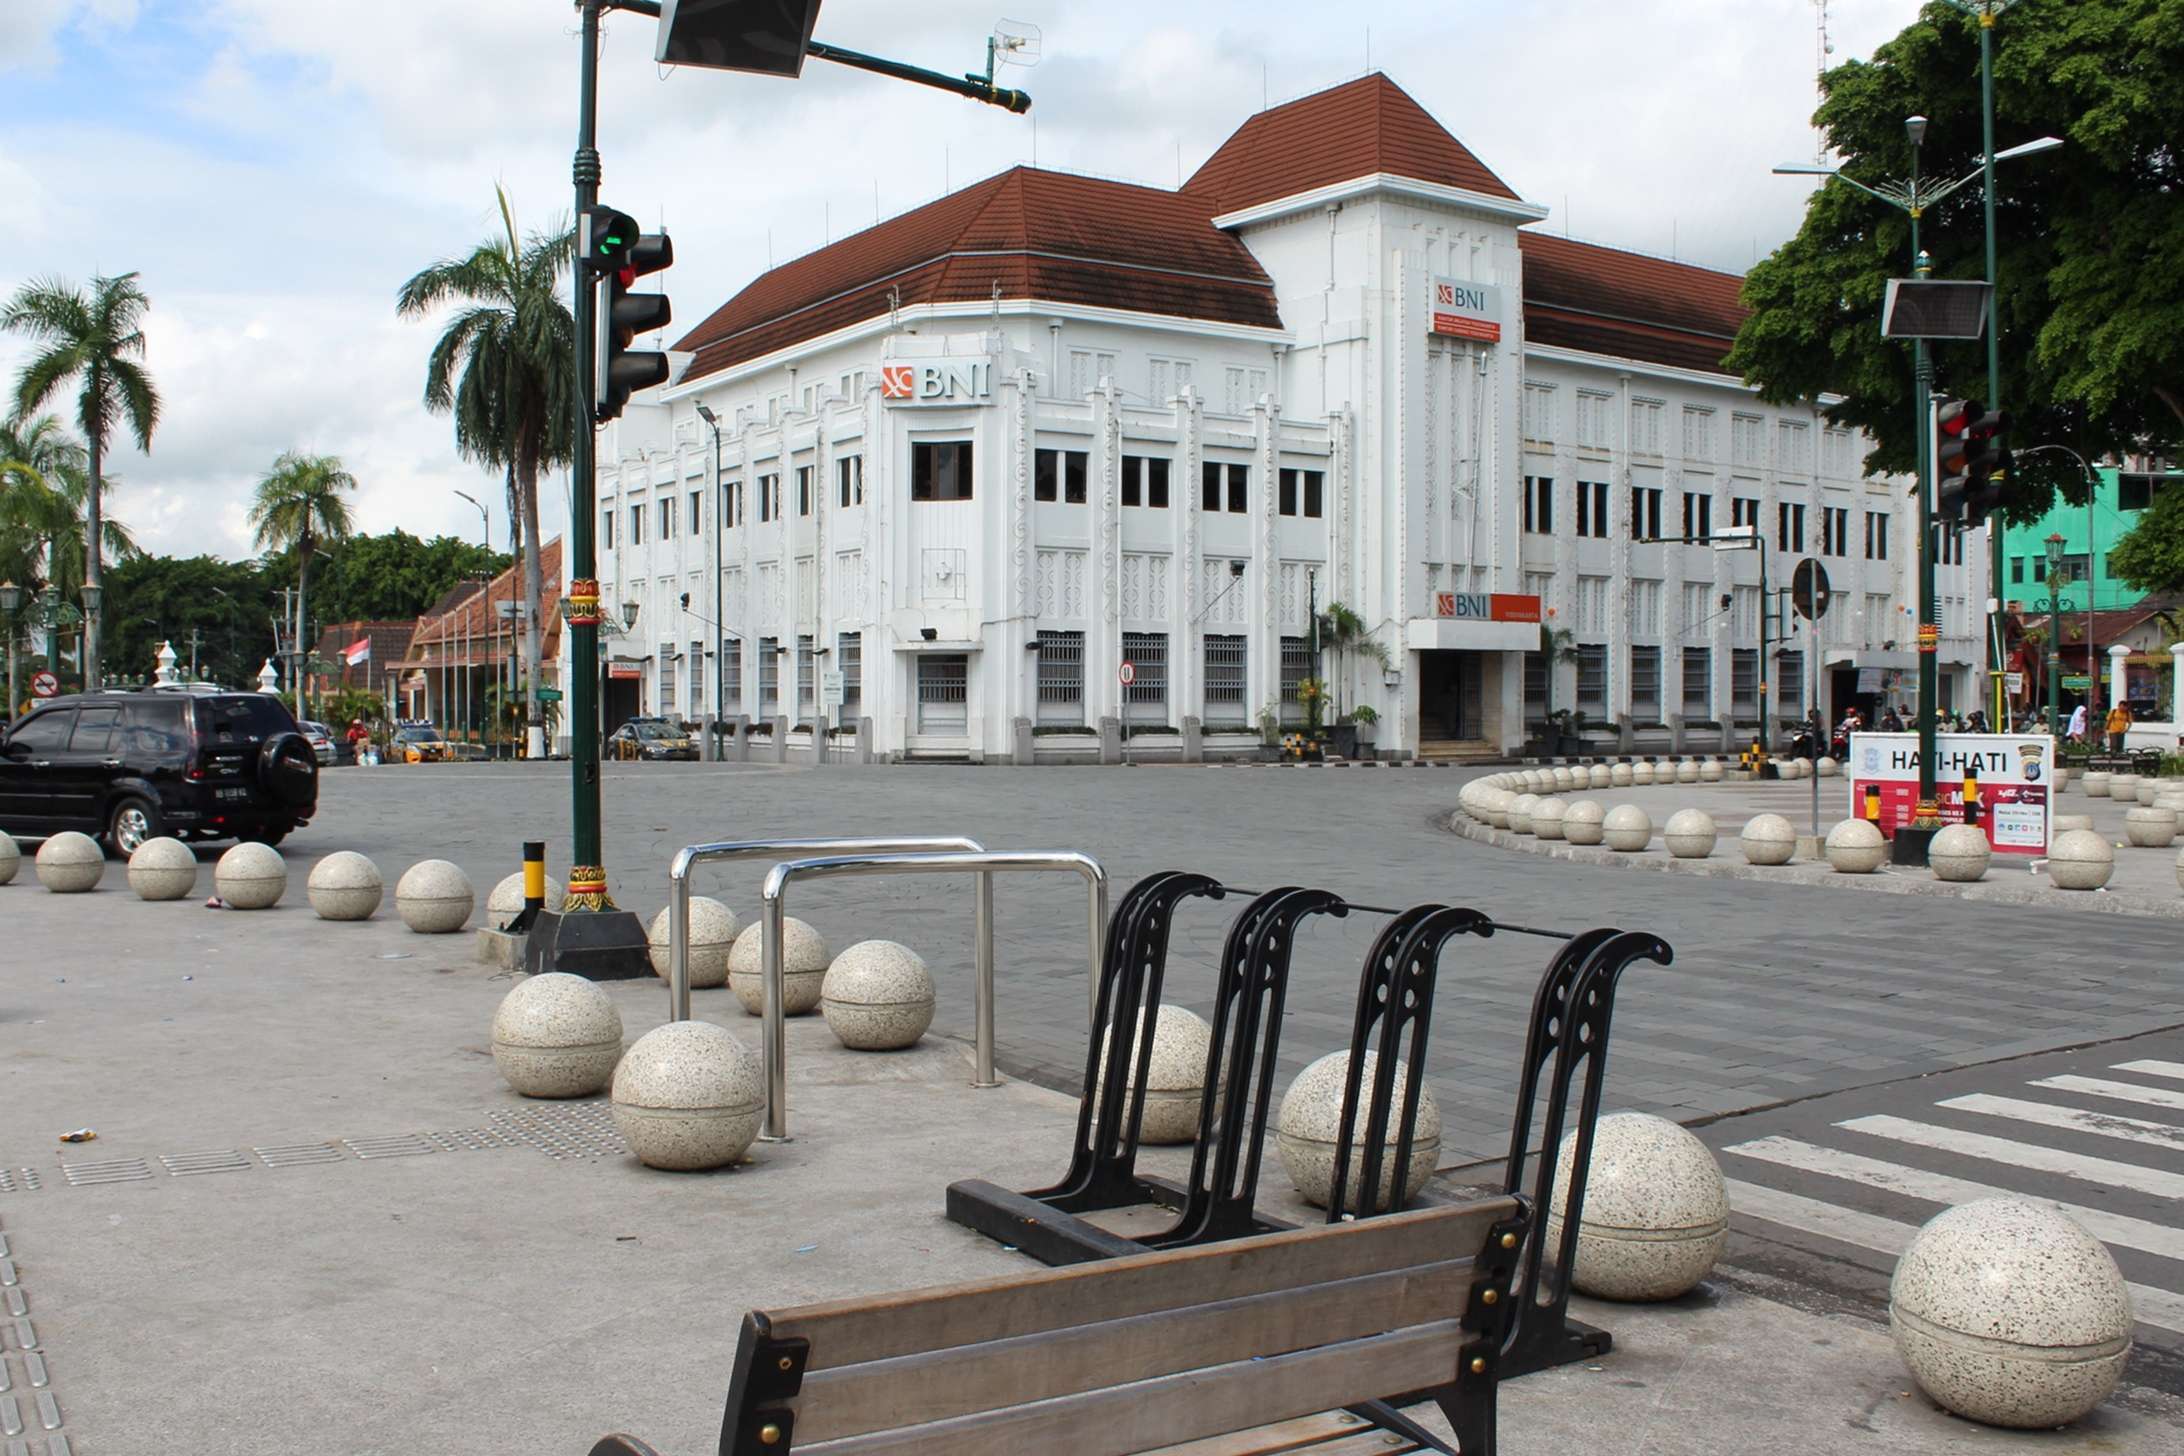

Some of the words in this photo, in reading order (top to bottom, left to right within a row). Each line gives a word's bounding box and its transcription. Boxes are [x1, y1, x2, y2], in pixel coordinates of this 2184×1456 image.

[1455, 287, 1484, 311] BNI
[919, 363, 991, 399] BNI
[1456, 594, 1487, 618] BNI
